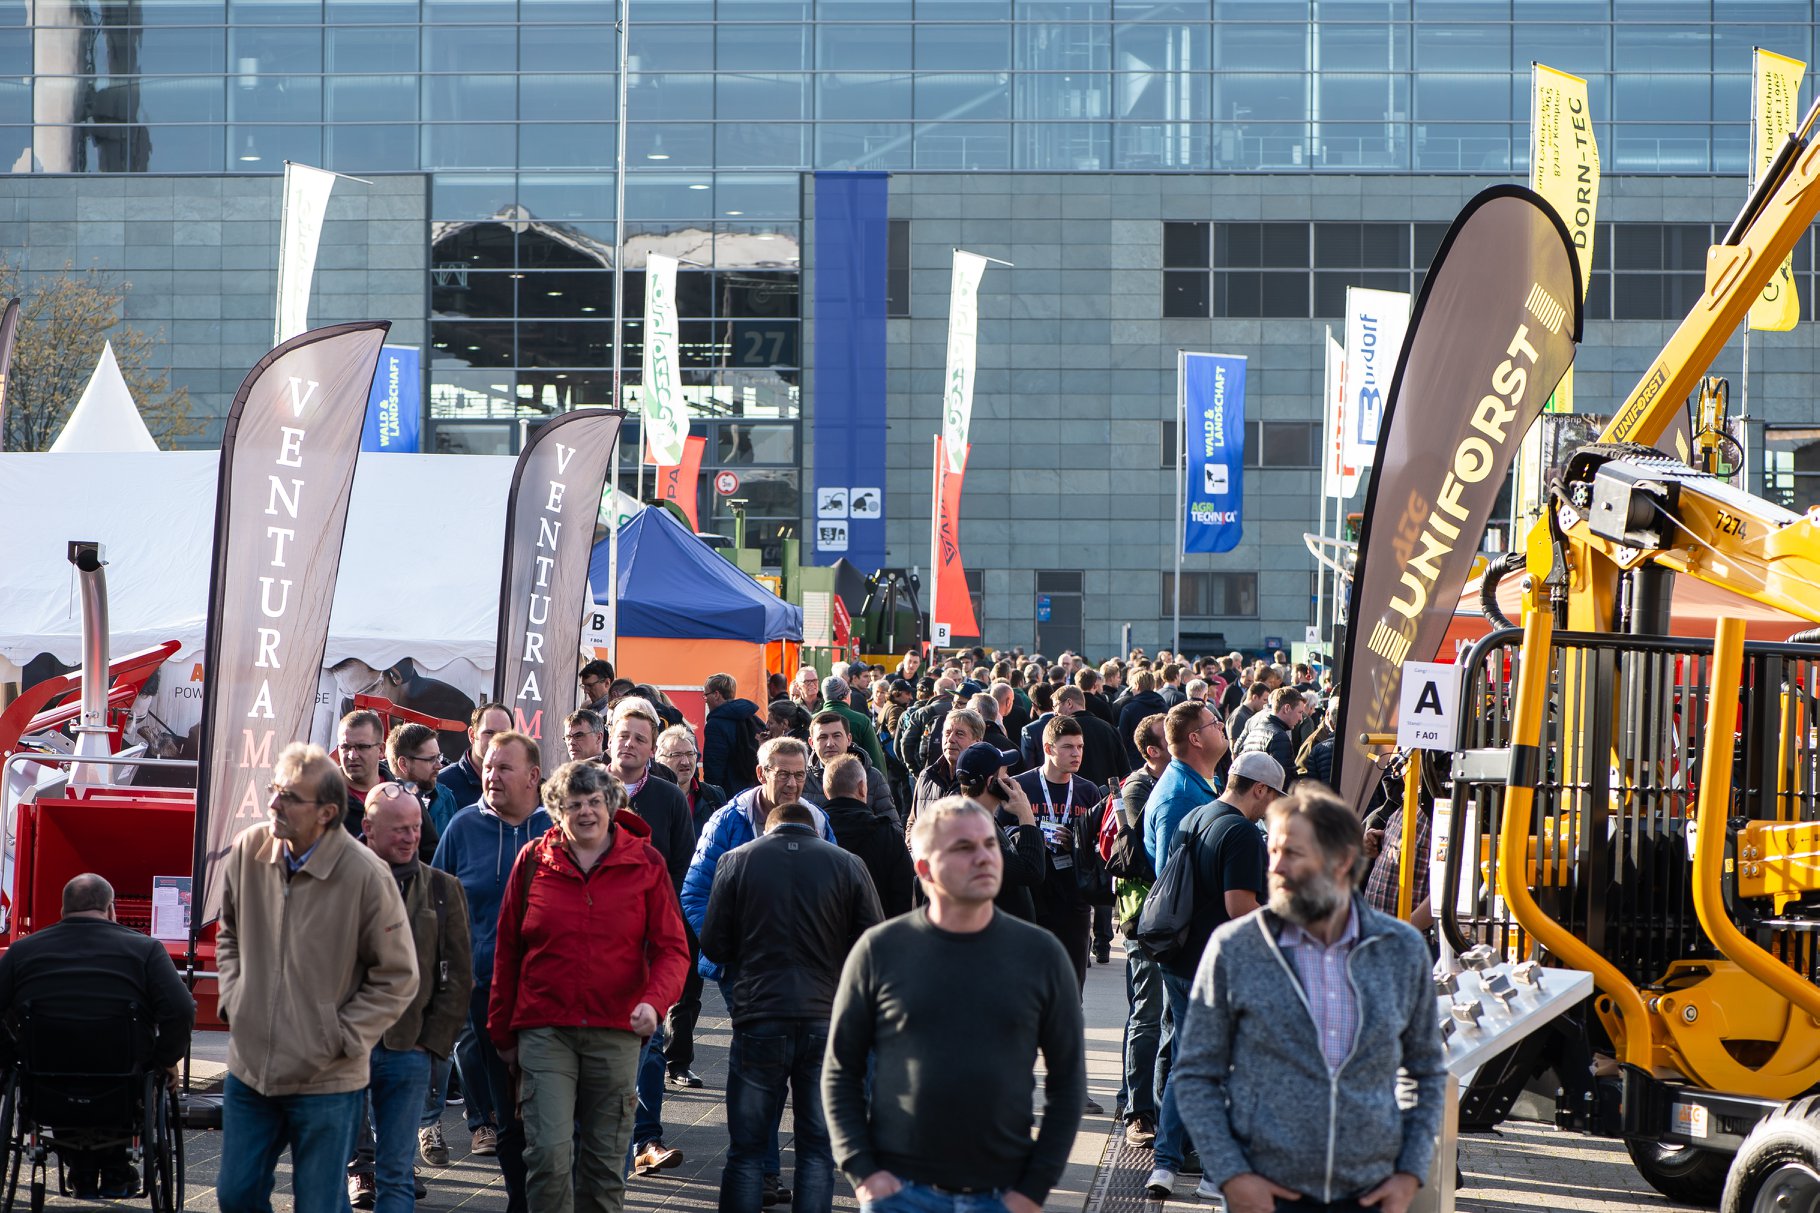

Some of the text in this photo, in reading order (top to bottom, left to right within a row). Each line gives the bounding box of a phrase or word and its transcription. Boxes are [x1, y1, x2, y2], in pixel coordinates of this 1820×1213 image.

[1568, 97, 1591, 249] DORN-TEC
[744, 331, 785, 363] 27
[389, 357, 399, 437] LANDSCHAFT
[1213, 366, 1226, 447] LANDSCHAFT
[1615, 371, 1663, 439] UNIFORST
[379, 399, 389, 447] WALD &
[1204, 408, 1214, 457] WALD &
[1389, 323, 1540, 619] UNIFORST
[1190, 502, 1214, 512] AGRI
[1191, 511, 1236, 525] TECHNICA
[1716, 510, 1747, 540] 7274
[513, 442, 576, 740] VENTURAM
[592, 613, 605, 631] B
[938, 627, 946, 638] B
[174, 687, 203, 699] POW
[315, 692, 330, 704] GE
[1414, 680, 1444, 716] A
[1415, 730, 1438, 740] F A01
